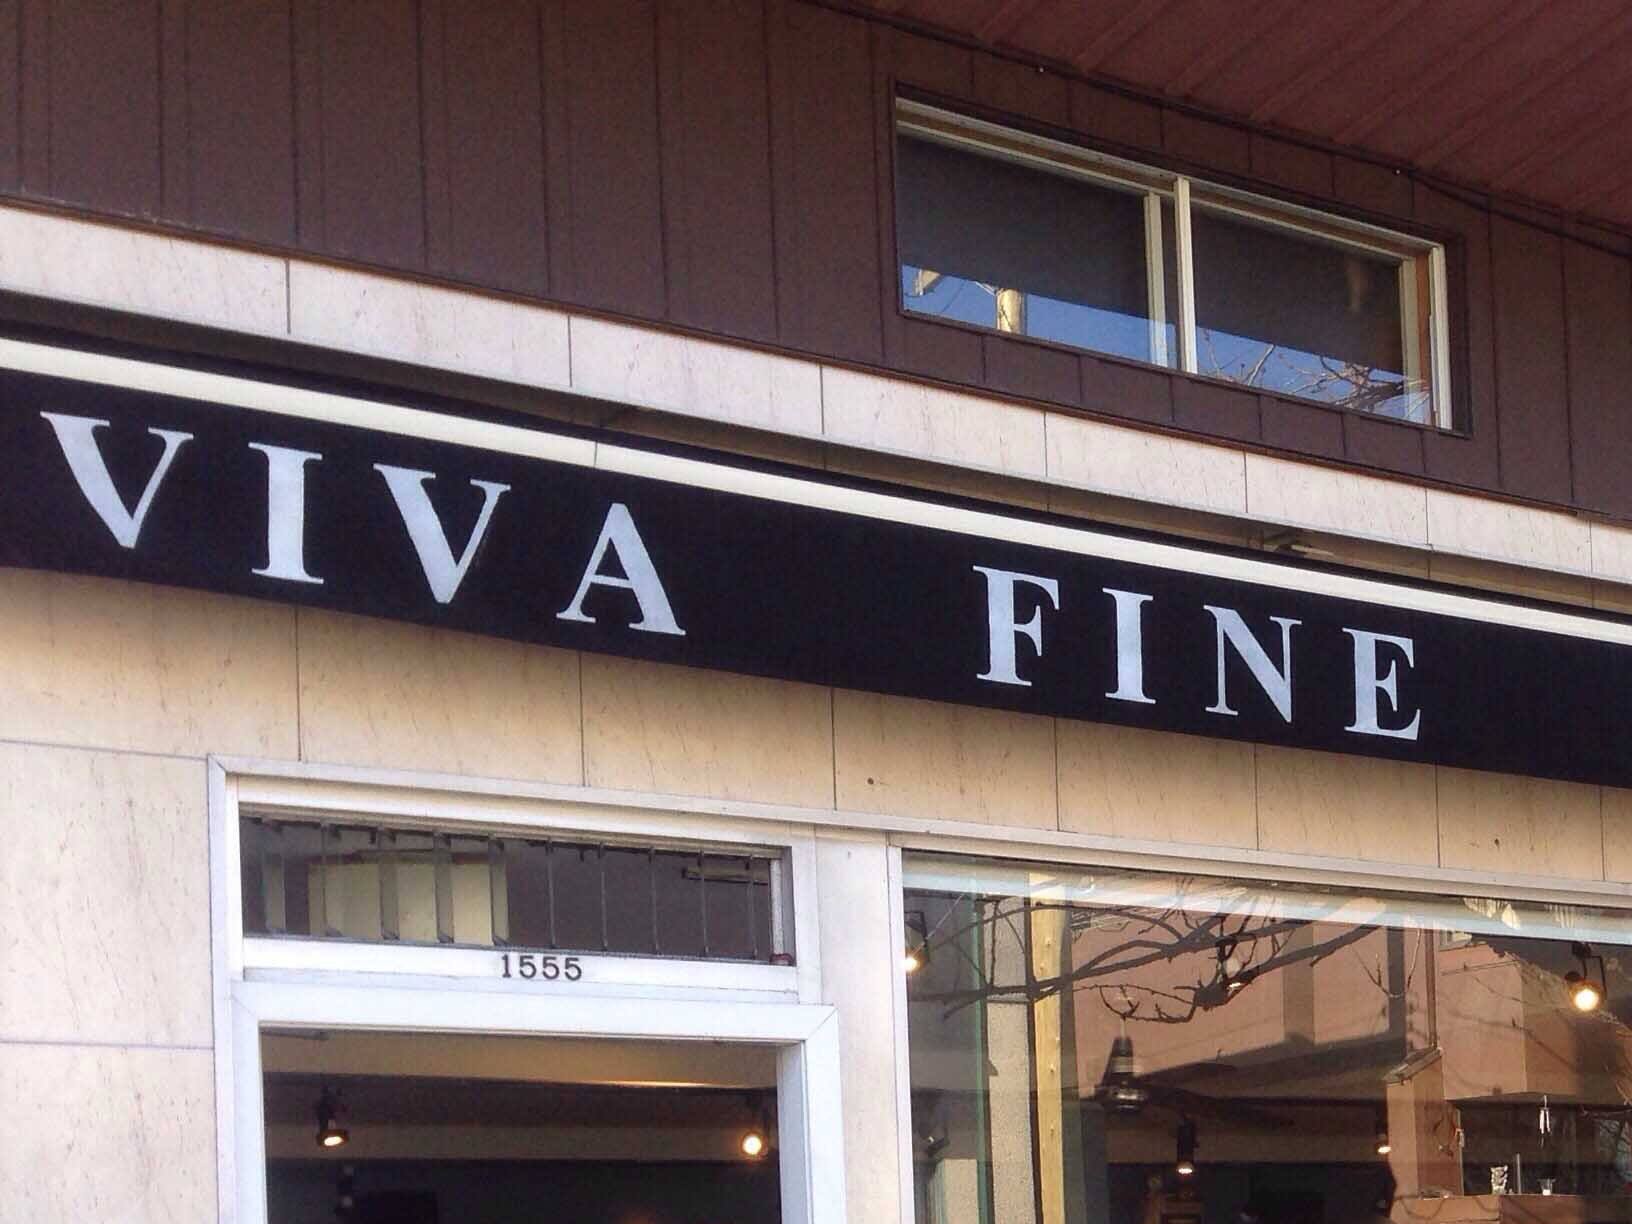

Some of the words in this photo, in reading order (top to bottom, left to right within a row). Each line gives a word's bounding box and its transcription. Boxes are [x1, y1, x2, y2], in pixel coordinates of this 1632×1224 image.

[40, 411, 686, 636] VIVA
[972, 565, 1421, 741] FINE
[501, 953, 582, 981] 1555
